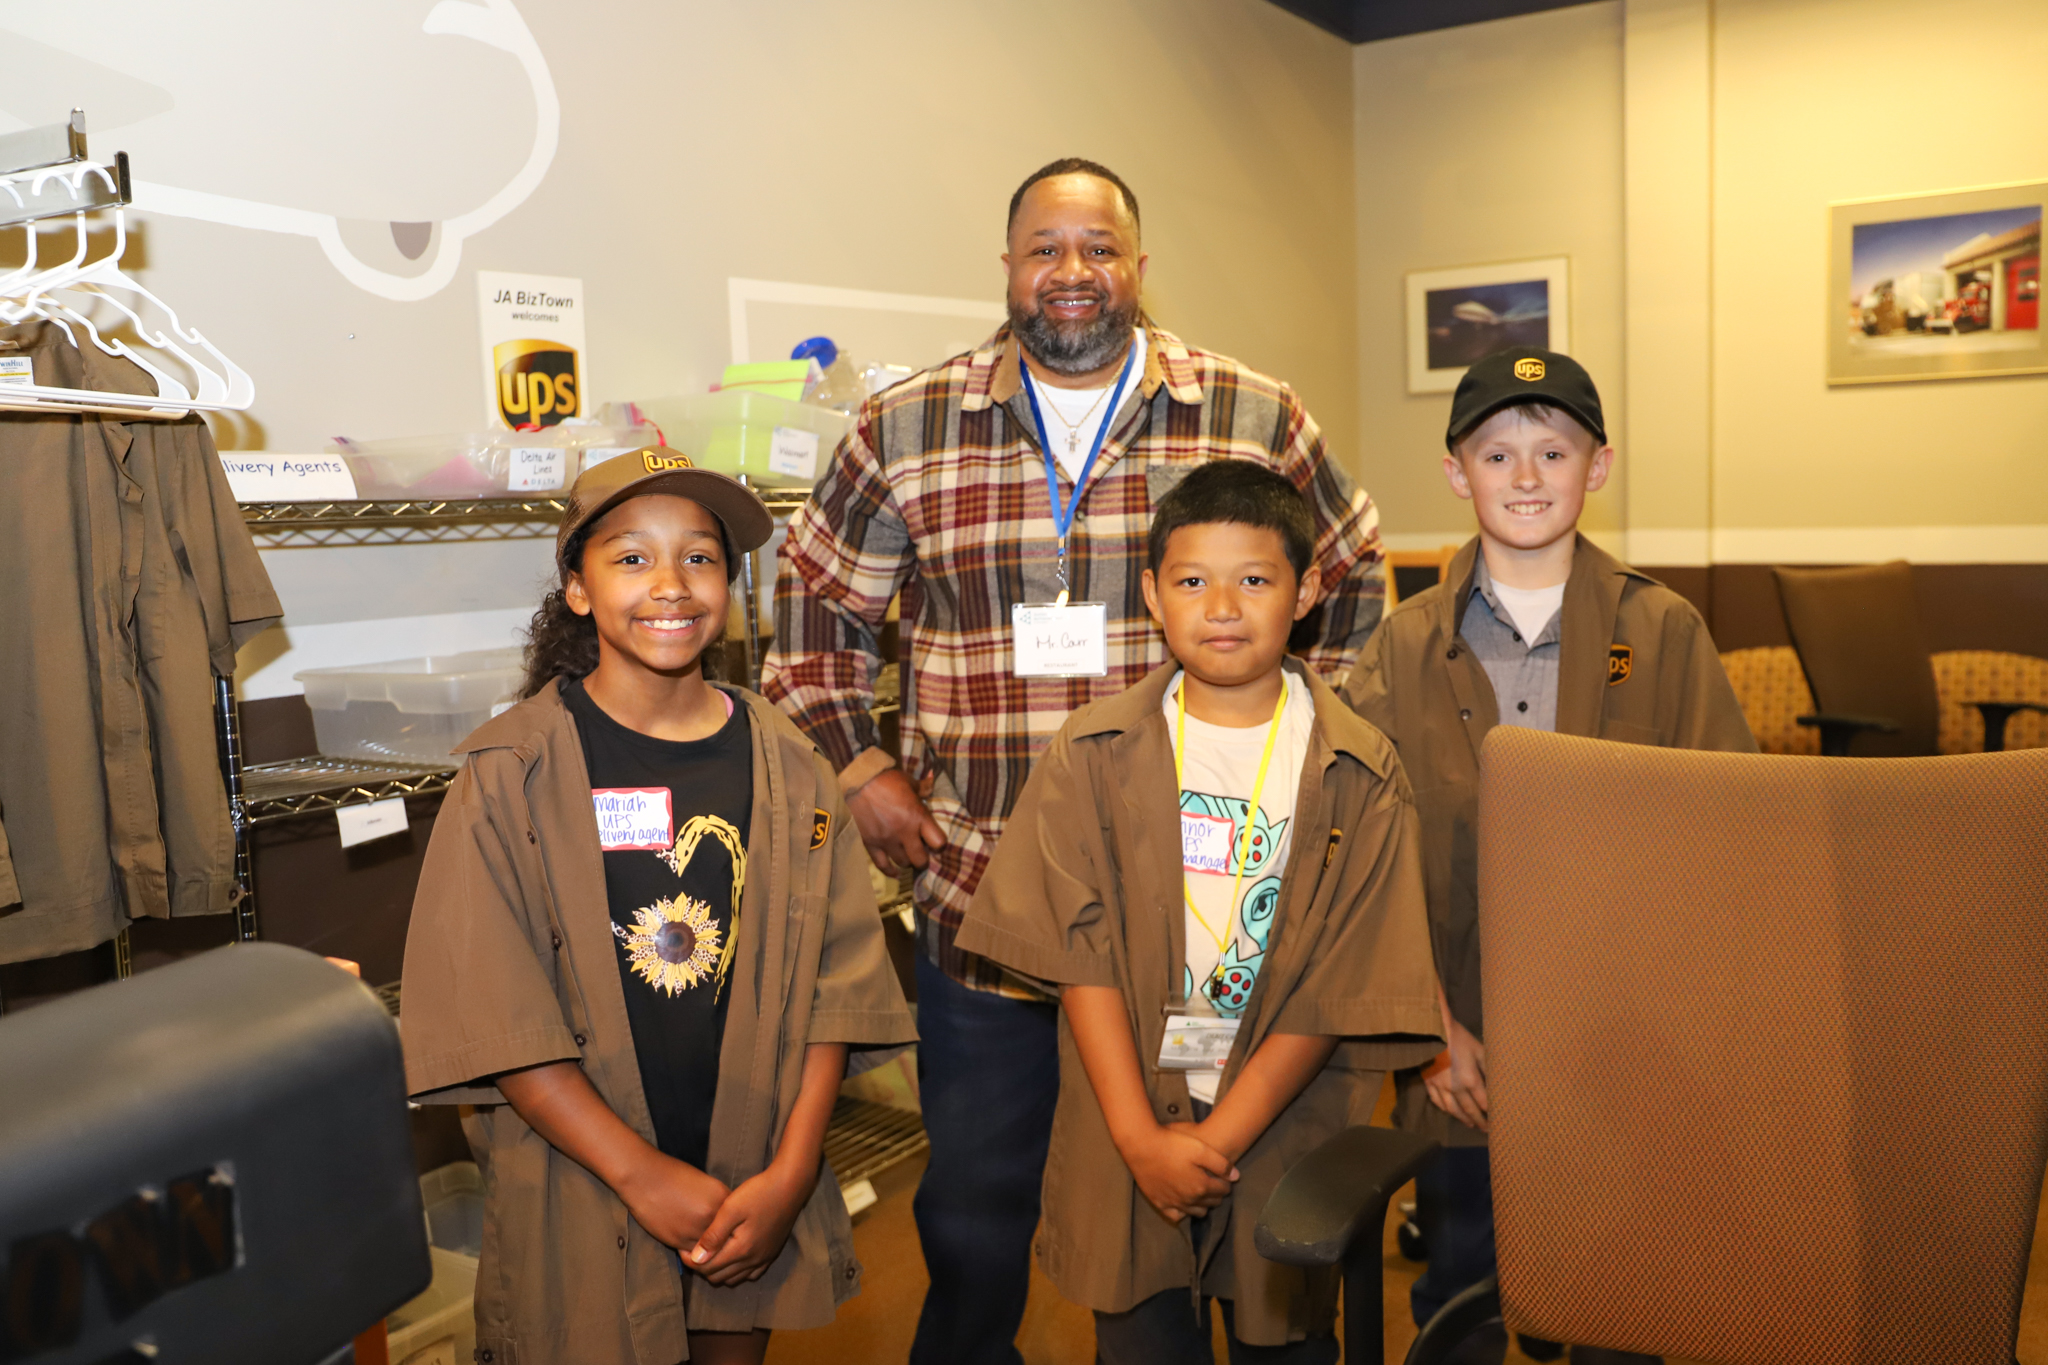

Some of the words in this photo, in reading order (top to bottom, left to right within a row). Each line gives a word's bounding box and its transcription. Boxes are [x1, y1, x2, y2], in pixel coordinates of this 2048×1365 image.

[493, 289, 512, 304] JA
[516, 291, 573, 308] BizTown
[511, 310, 560, 323] welcomes
[1517, 363, 1543, 378] ups
[521, 450, 543, 463] Delta
[546, 452, 557, 461] Air
[222, 459, 274, 477] livery
[283, 460, 341, 477] Agents
[1036, 634, 1059, 650] Mr.
[1060, 631, 1088, 649] Carr
[1609, 657, 1629, 678] ps
[603, 813, 634, 830] UPS
